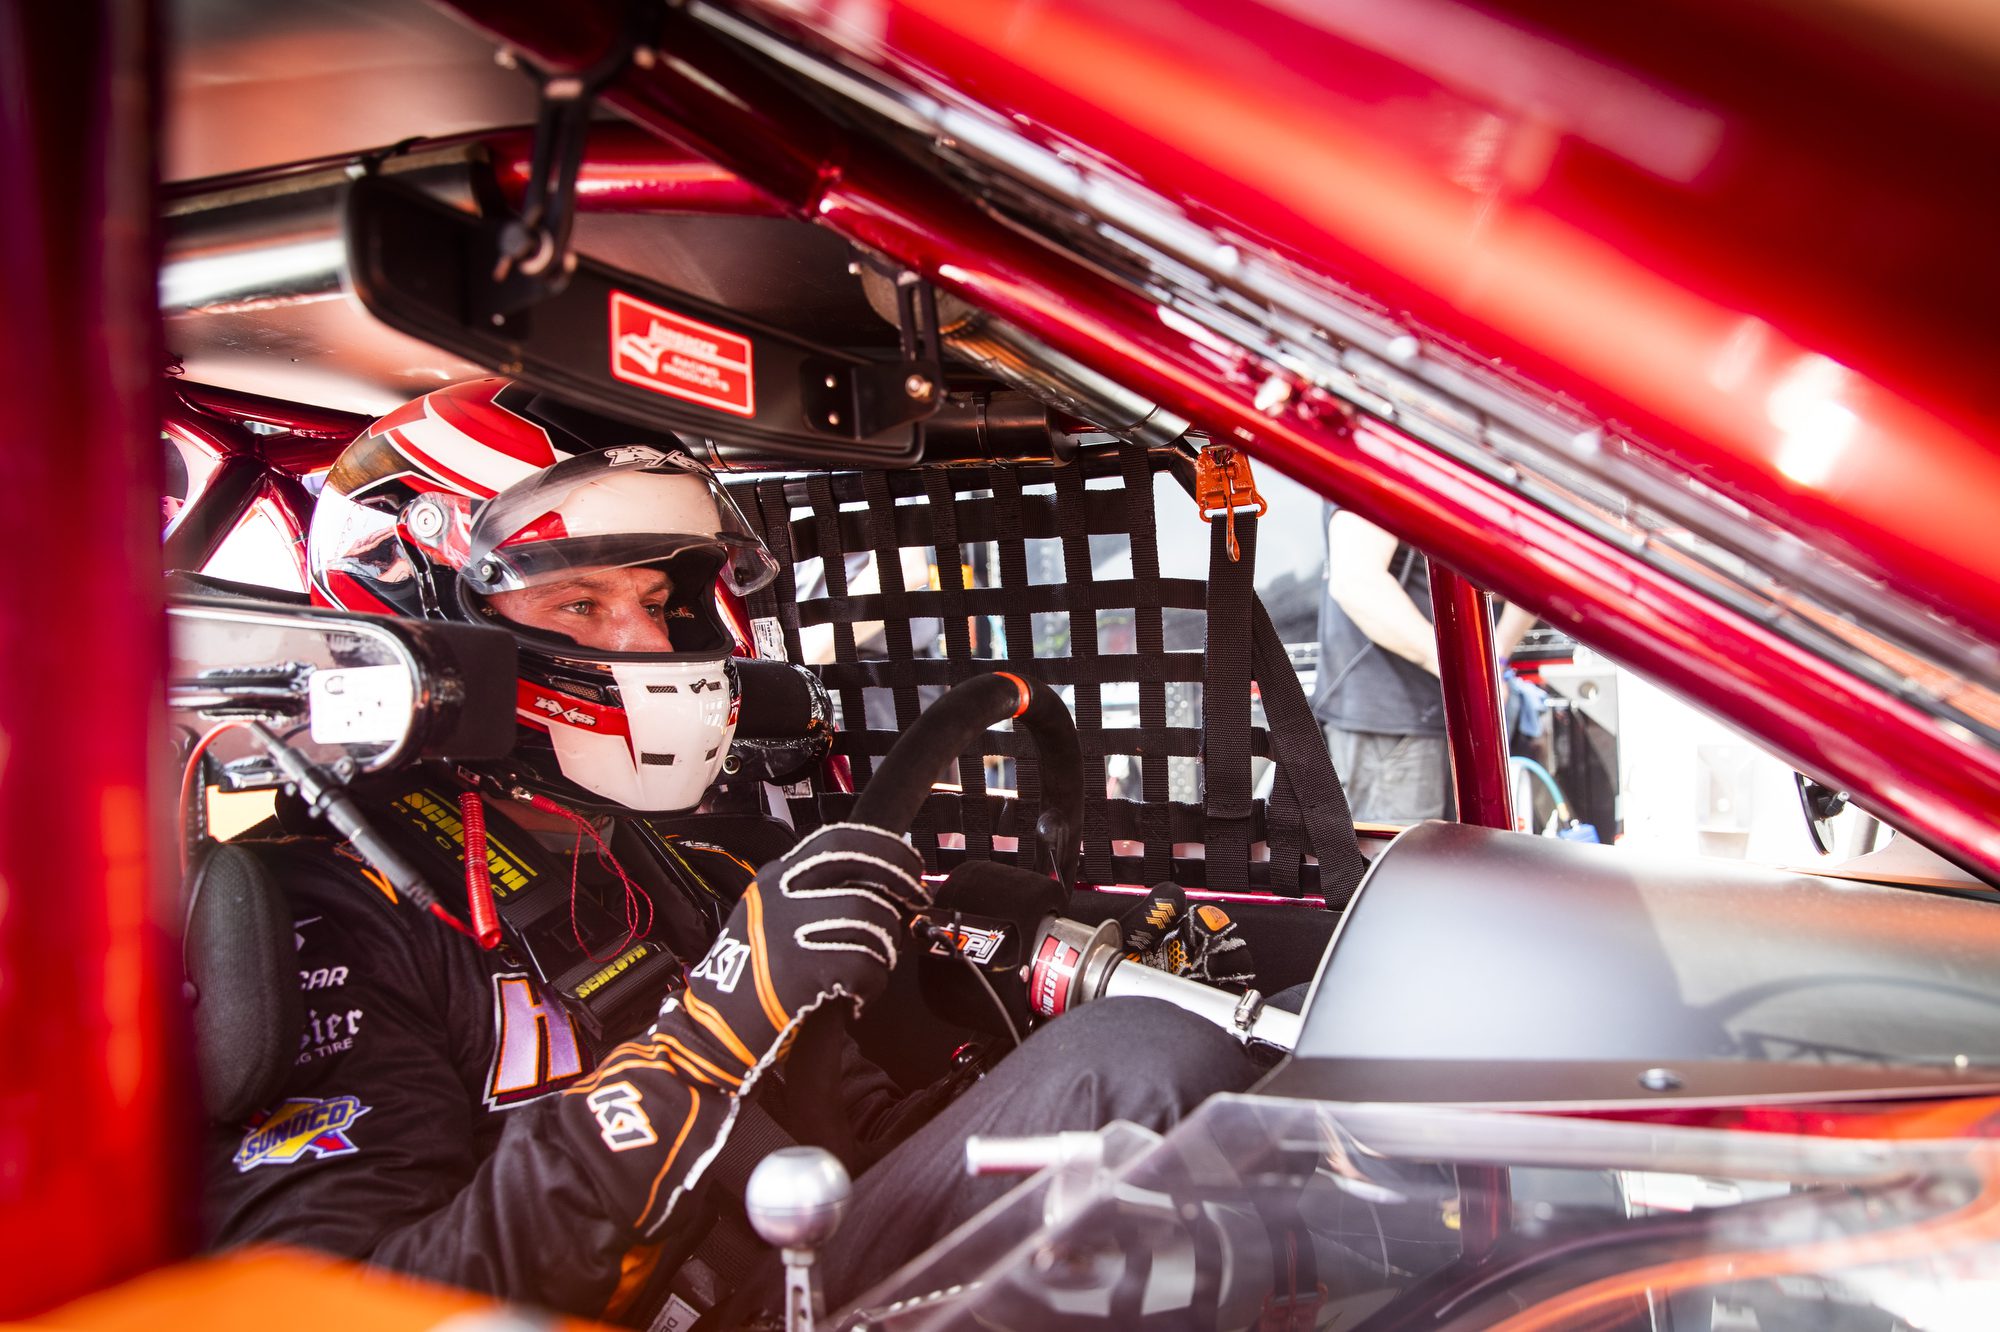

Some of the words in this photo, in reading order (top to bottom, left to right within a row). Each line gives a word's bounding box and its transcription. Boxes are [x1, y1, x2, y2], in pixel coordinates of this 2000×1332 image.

[402, 792, 529, 892] SCHTH
[300, 1009, 363, 1049] ier
[317, 1037, 354, 1058] TIRE
[244, 1102, 348, 1161] SUNOCO
[587, 1080, 658, 1152] K1
